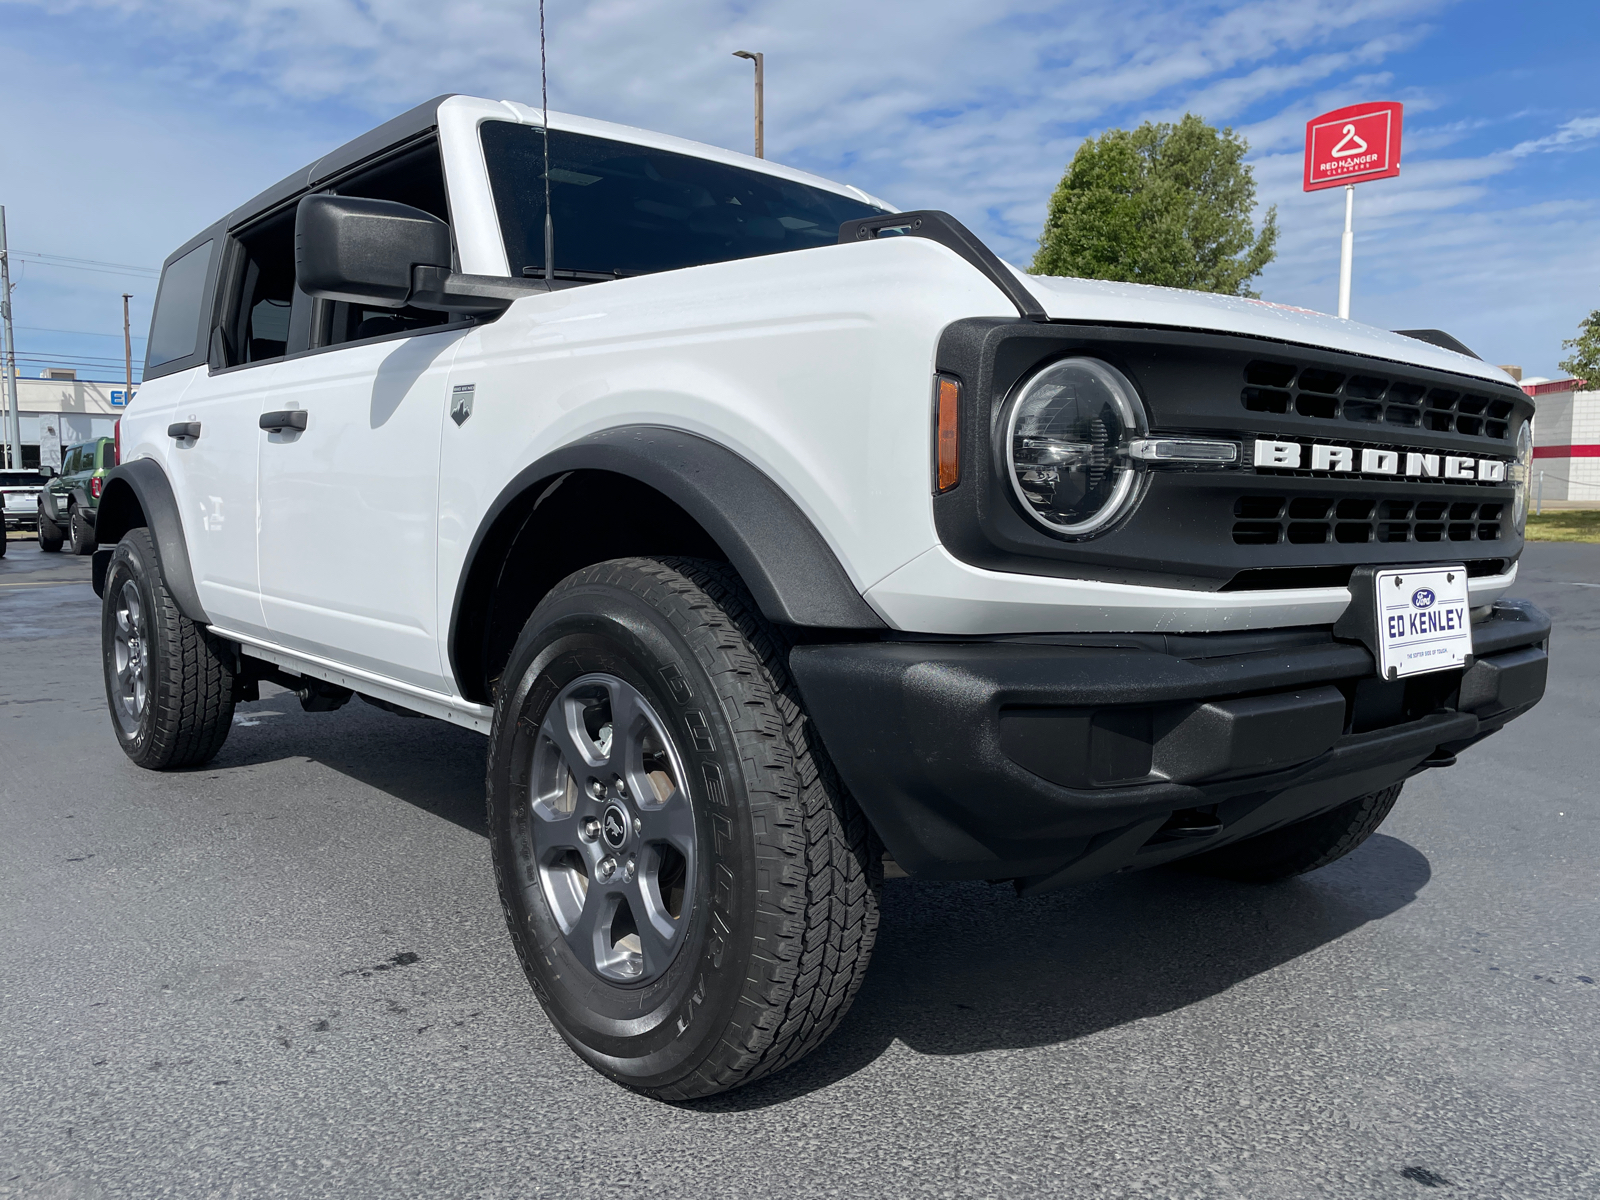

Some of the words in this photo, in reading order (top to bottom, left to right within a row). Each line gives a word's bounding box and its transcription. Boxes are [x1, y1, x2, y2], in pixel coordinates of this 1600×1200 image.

[1320, 162, 1337, 171] RED
[1339, 154, 1378, 167] HANGER
[1327, 163, 1370, 175] CLEANERS
[1254, 439, 1504, 482] BRONCO
[1416, 591, 1431, 607] Ford
[1388, 615, 1405, 638] ED
[1409, 608, 1464, 635] KENLEY
[657, 661, 735, 968] DUELER
